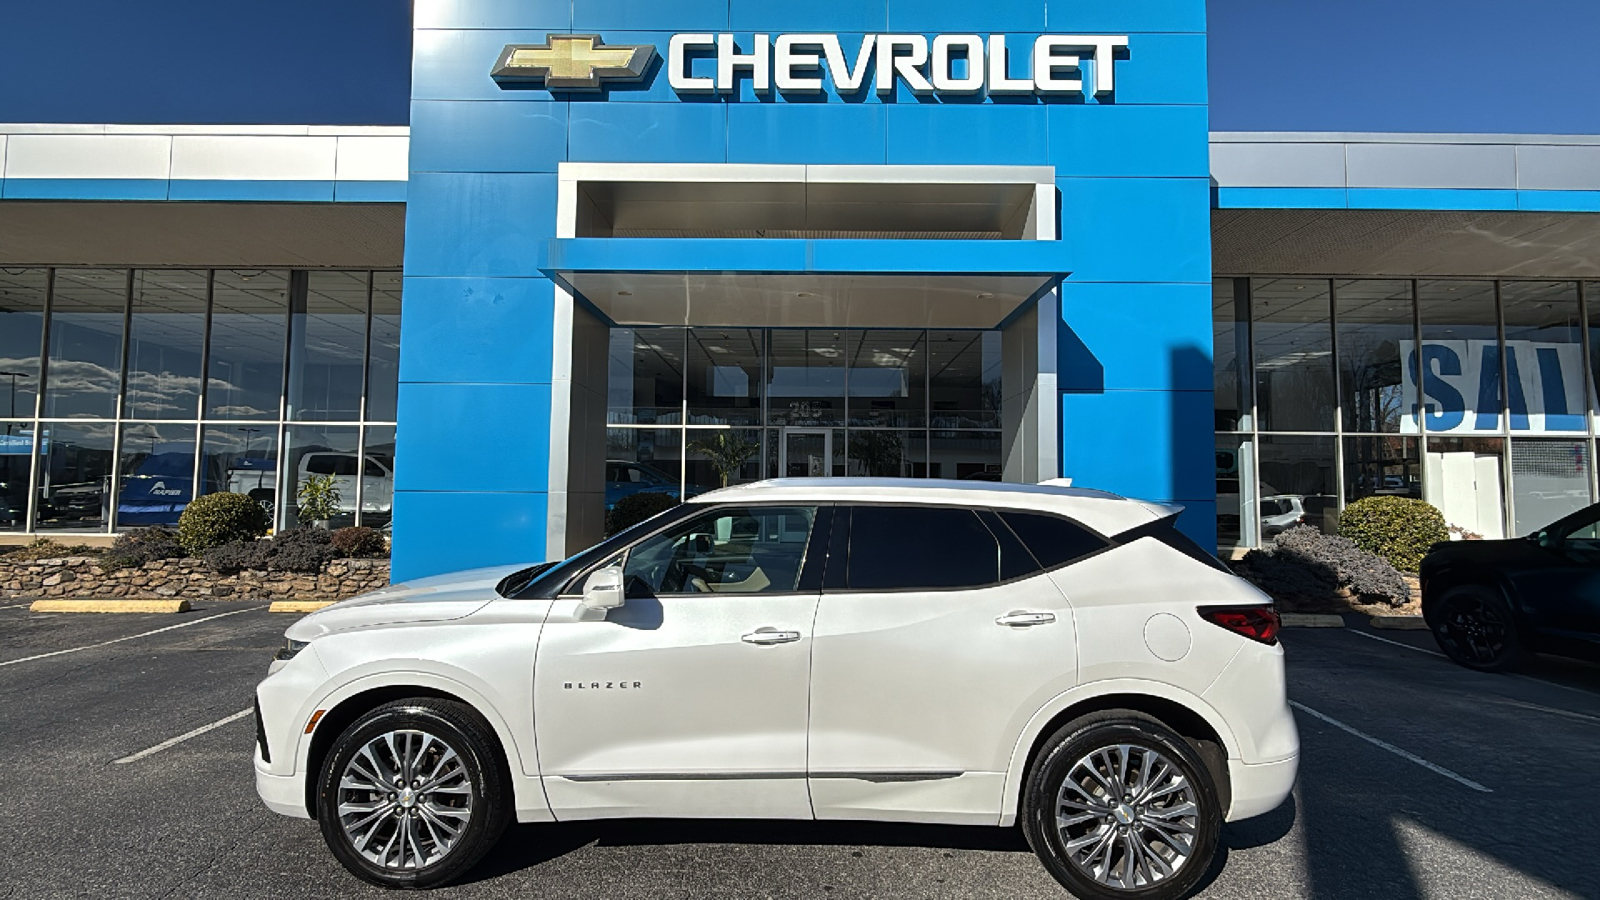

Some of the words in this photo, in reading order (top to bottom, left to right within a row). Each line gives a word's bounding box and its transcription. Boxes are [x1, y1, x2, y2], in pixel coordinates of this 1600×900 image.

[667, 33, 1129, 95] CHEVROLET
[789, 401, 822, 418] 205
[564, 681, 642, 689] BLAZER
